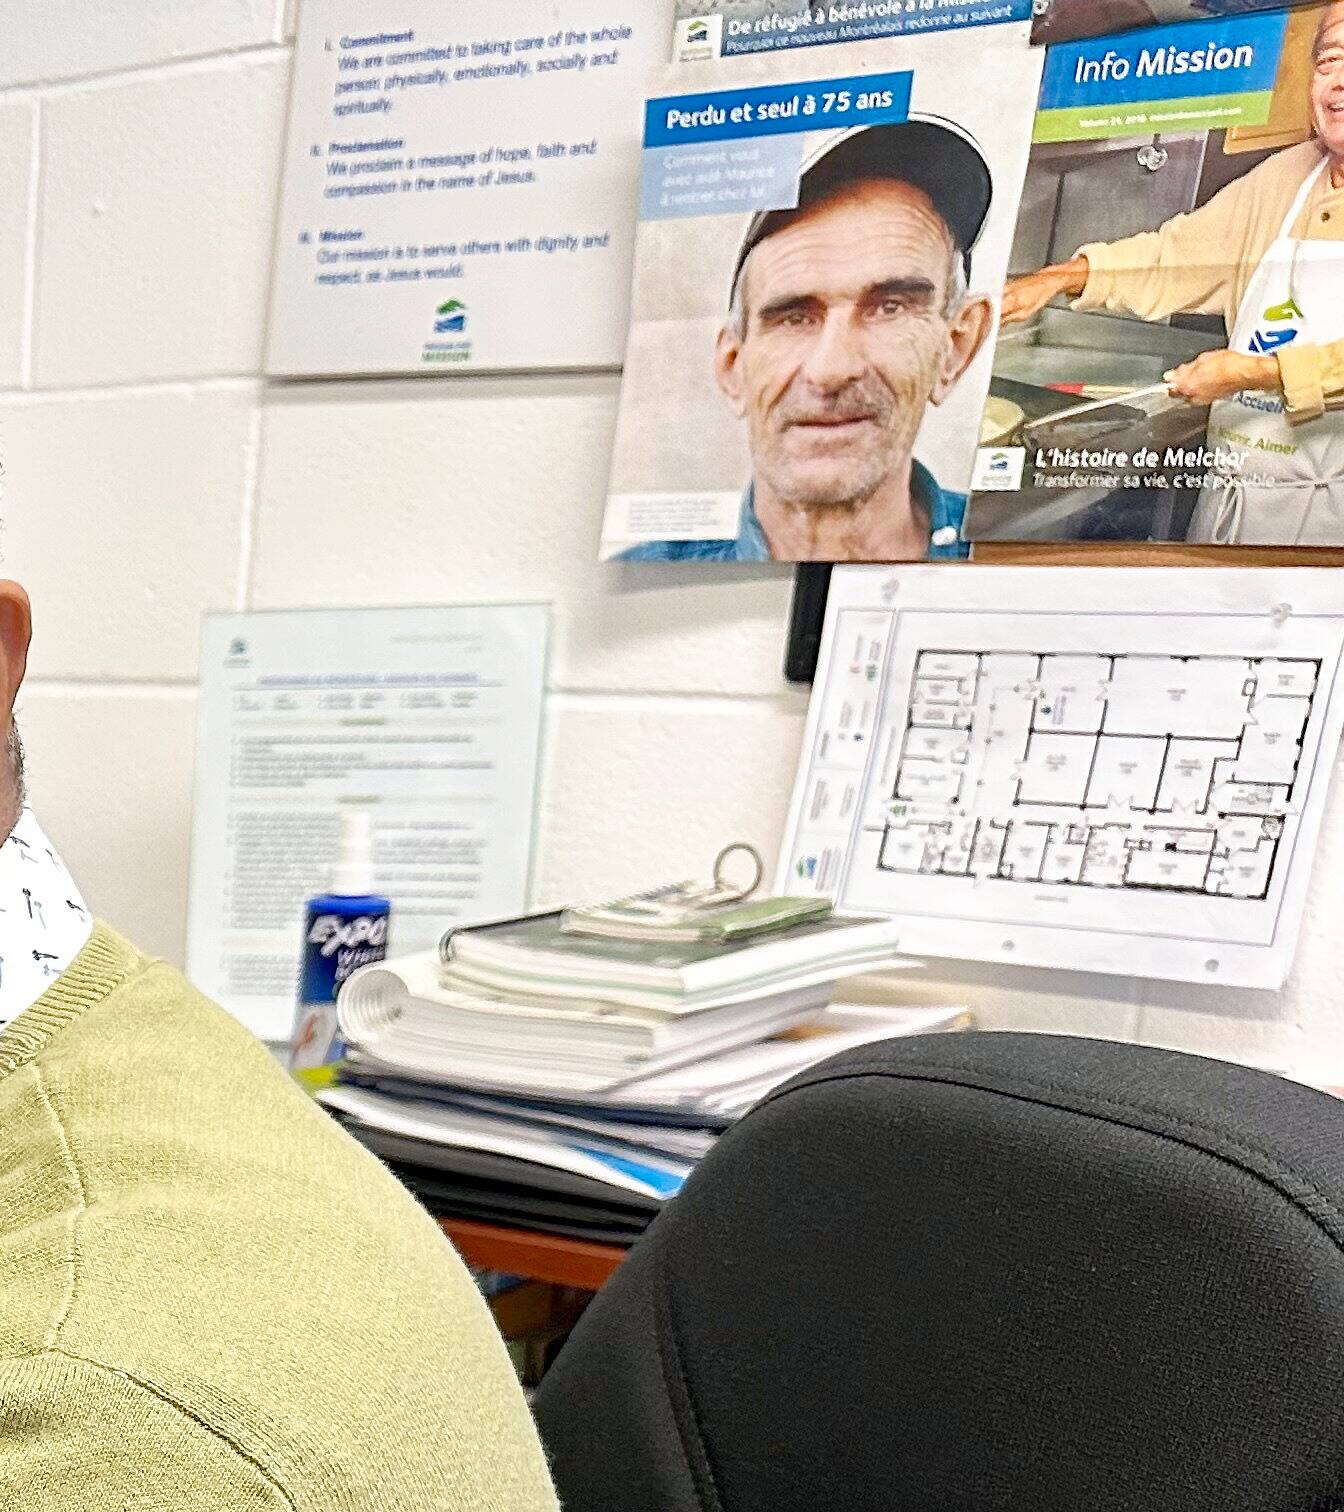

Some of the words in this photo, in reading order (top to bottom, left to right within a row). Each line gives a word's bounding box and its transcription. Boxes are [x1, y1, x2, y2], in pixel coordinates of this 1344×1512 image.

[728, 18, 750, 36] De
[754, 8, 812, 35] réfugié
[385, 46, 453, 67] committed
[471, 40, 512, 58] taking
[514, 35, 545, 52] care
[547, 31, 563, 48] of
[565, 30, 587, 46] the
[590, 24, 633, 44] whole
[1075, 51, 1130, 83] Info
[1135, 41, 1255, 79] Mission
[667, 99, 725, 129] Perdu
[730, 102, 751, 122] et
[757, 95, 798, 121] seul
[802, 93, 815, 115] à
[823, 91, 850, 113] 75
[857, 89, 893, 110] ans
[1035, 447, 1128, 469] L'histoire
[1133, 446, 1160, 468] de
[1164, 447, 1250, 469] Melchor
[1033, 471, 1120, 489] Transformer
[1123, 475, 1140, 489] sa
